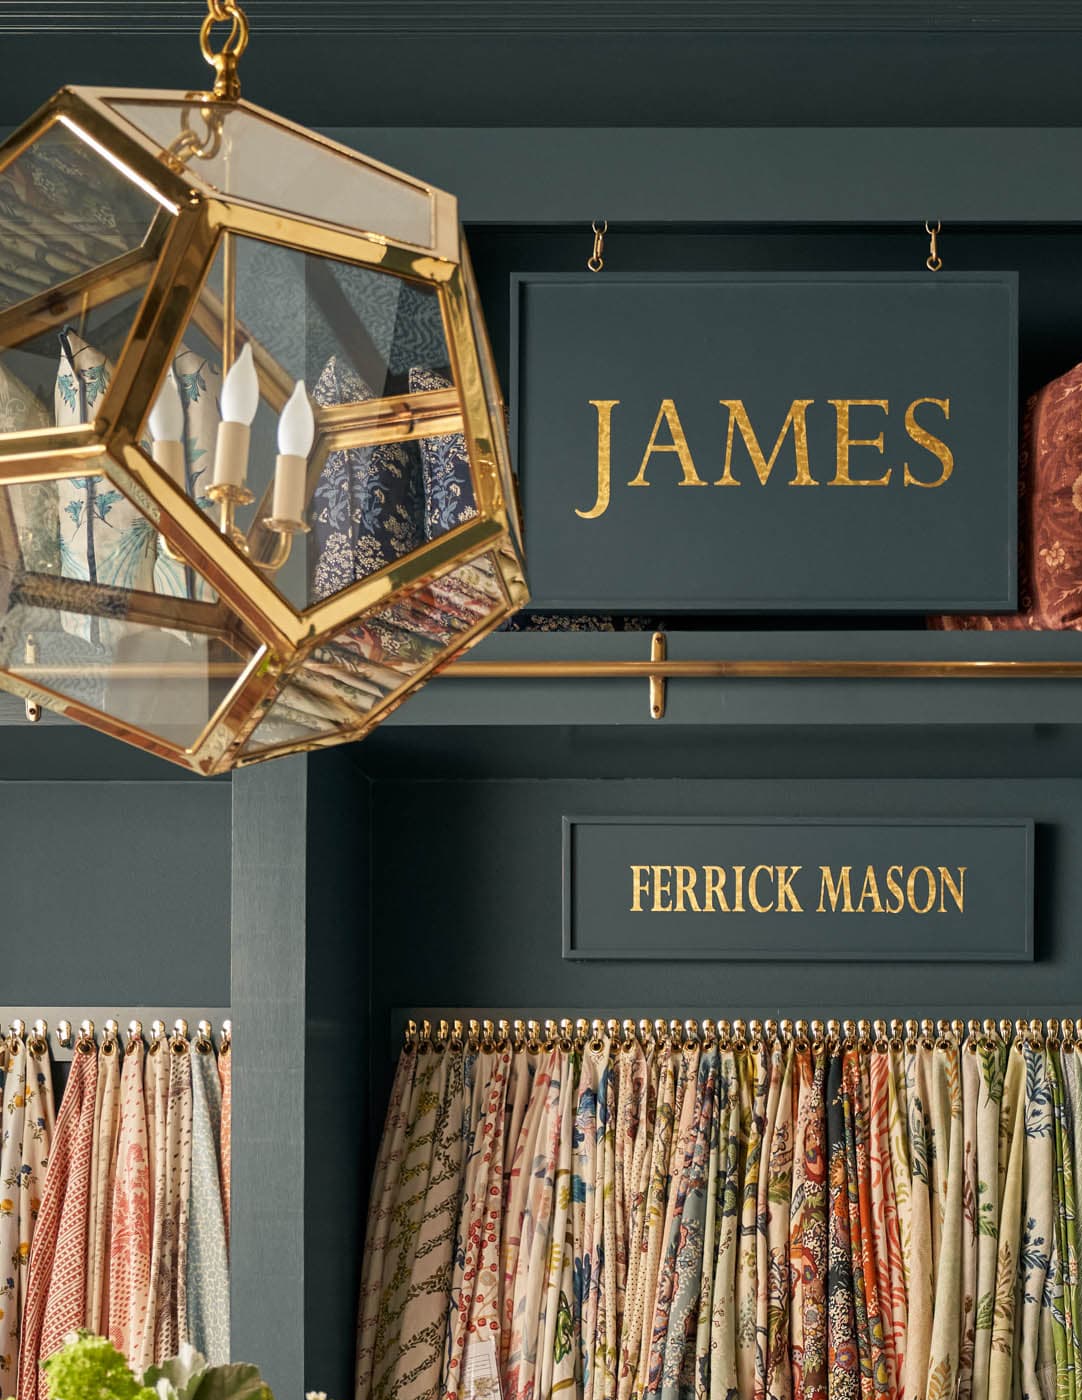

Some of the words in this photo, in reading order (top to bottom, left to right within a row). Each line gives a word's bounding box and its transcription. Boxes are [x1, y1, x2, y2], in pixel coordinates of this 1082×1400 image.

[574, 396, 956, 520] JAMES
[629, 863, 804, 913] FERRICK
[815, 864, 967, 913] MASON
